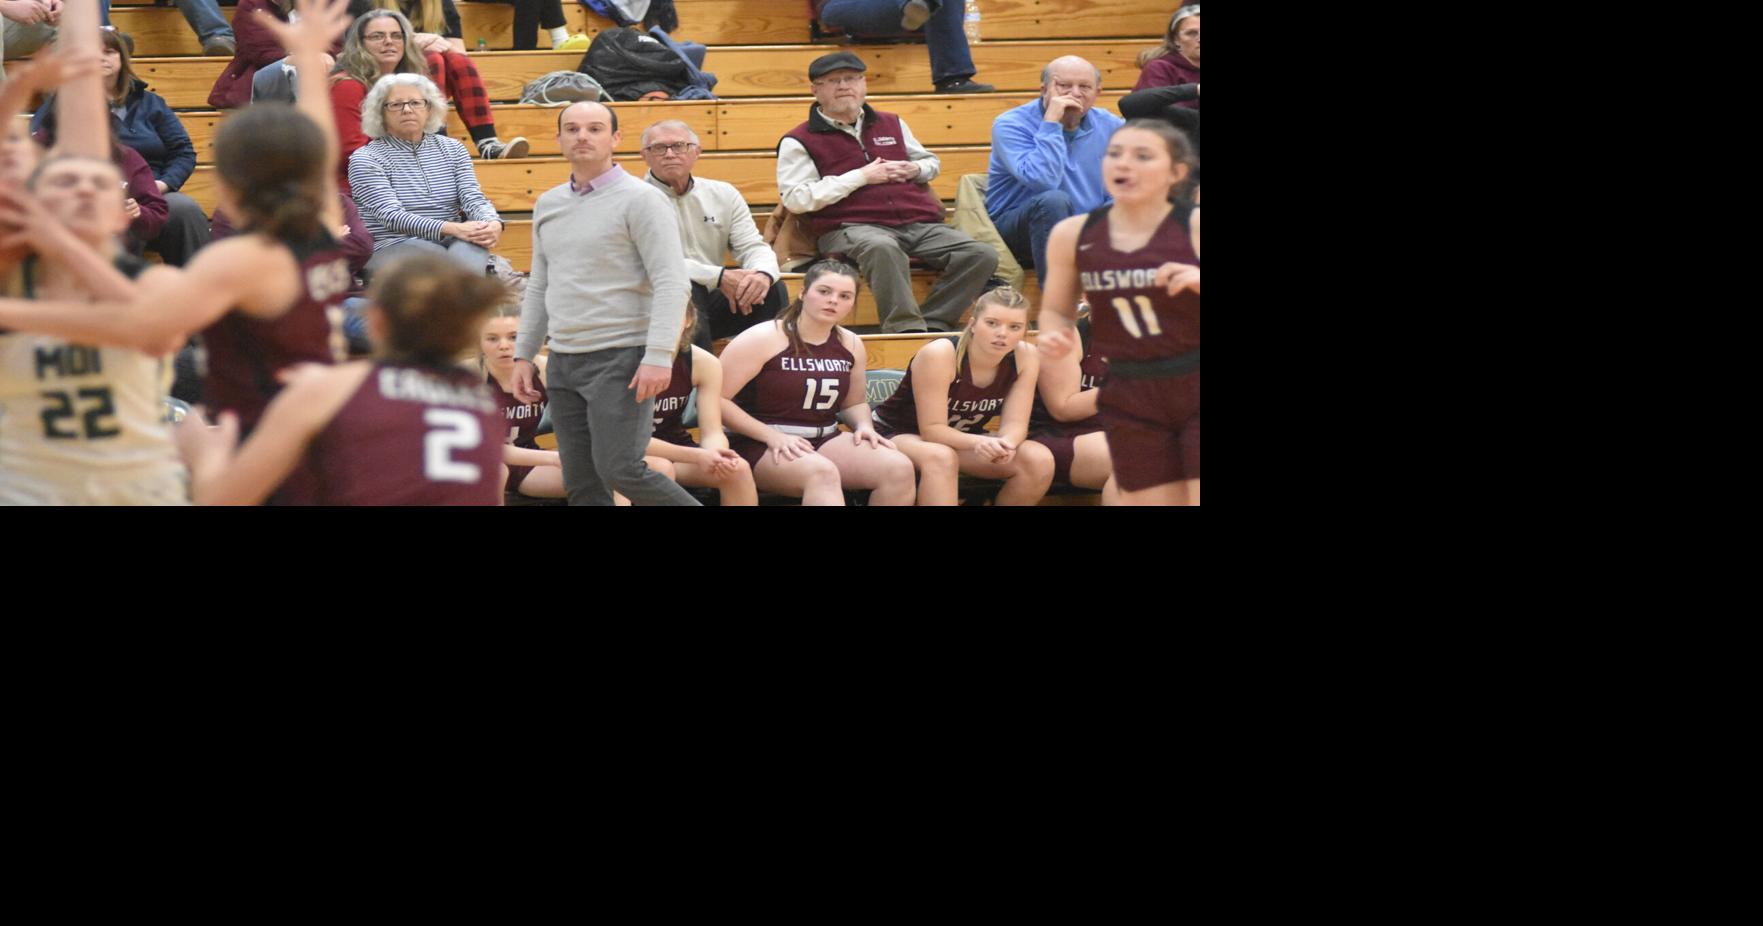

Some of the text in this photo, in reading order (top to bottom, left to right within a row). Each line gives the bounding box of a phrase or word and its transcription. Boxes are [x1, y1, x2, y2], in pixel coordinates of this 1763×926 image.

[1111, 295, 1161, 338] 11
[40, 387, 121, 440] 22
[802, 378, 840, 410] 15
[424, 407, 482, 484] 2
